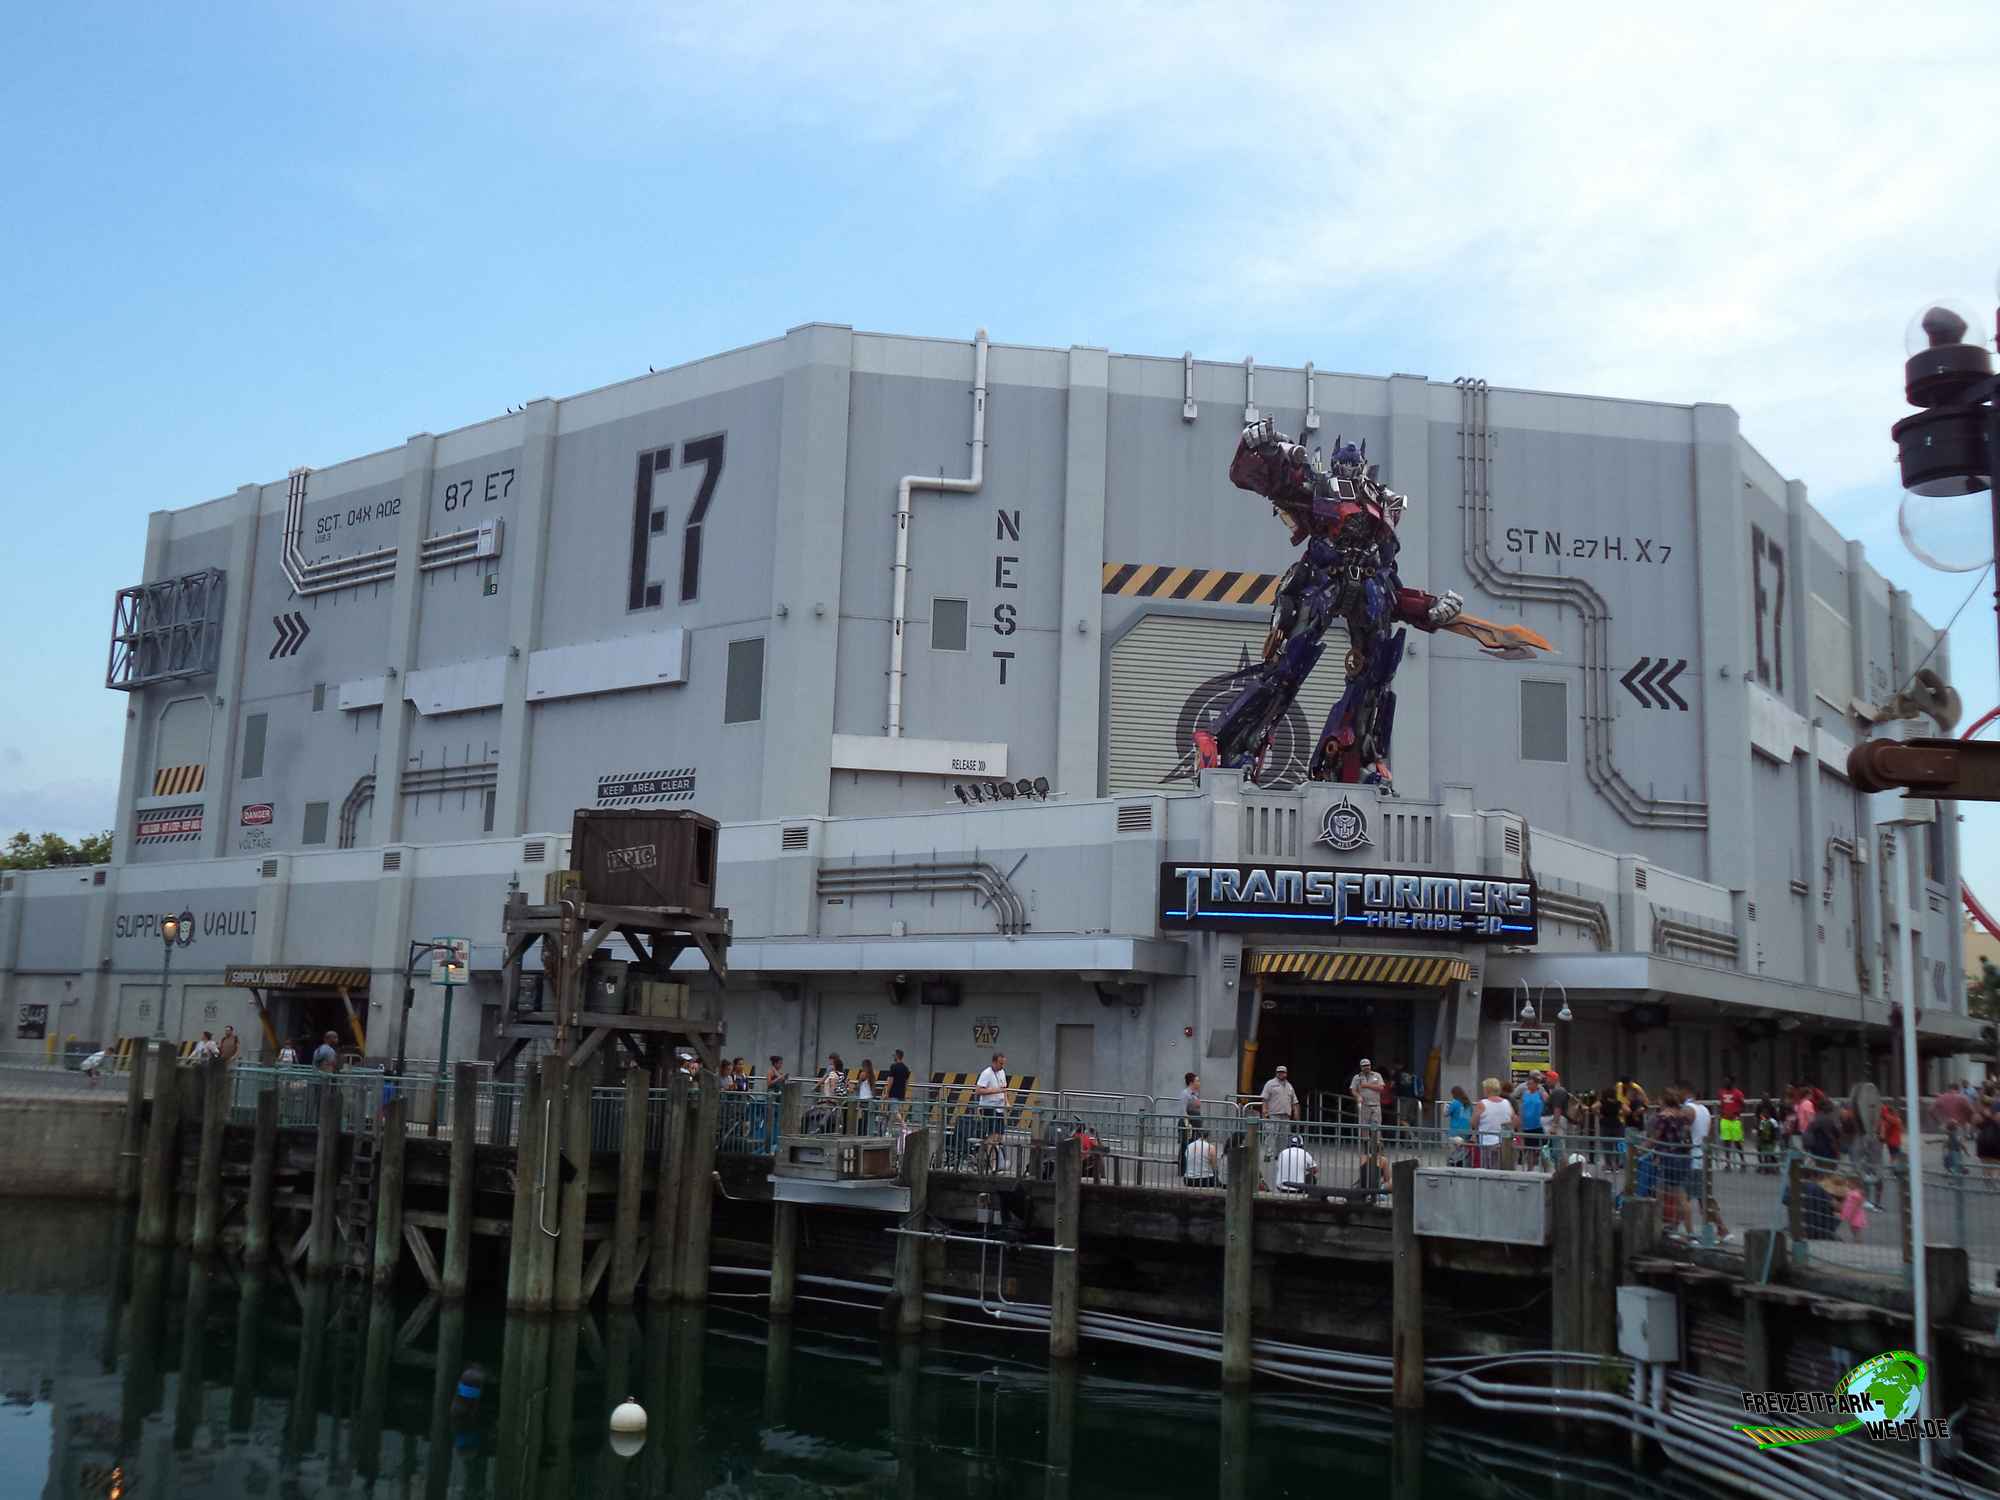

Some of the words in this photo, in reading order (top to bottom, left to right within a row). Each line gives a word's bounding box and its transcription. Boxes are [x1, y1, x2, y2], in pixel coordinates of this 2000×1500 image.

[445, 479, 473, 511] 87
[485, 468, 515, 501] E7
[627, 432, 727, 613] E7
[993, 509, 1020, 685] NEST
[1752, 520, 1785, 697] E7
[952, 759, 977, 771] RELEASE
[602, 785, 625, 796] KEEP
[632, 782, 655, 793] AREA
[661, 779, 690, 791] CLEAR
[244, 809, 271, 820] DANGER
[239, 838, 272, 850] VOLTAGE
[1175, 867, 1531, 926] TRANSFORMERS
[116, 914, 166, 938] SUPPL
[1364, 911, 1409, 929] THE
